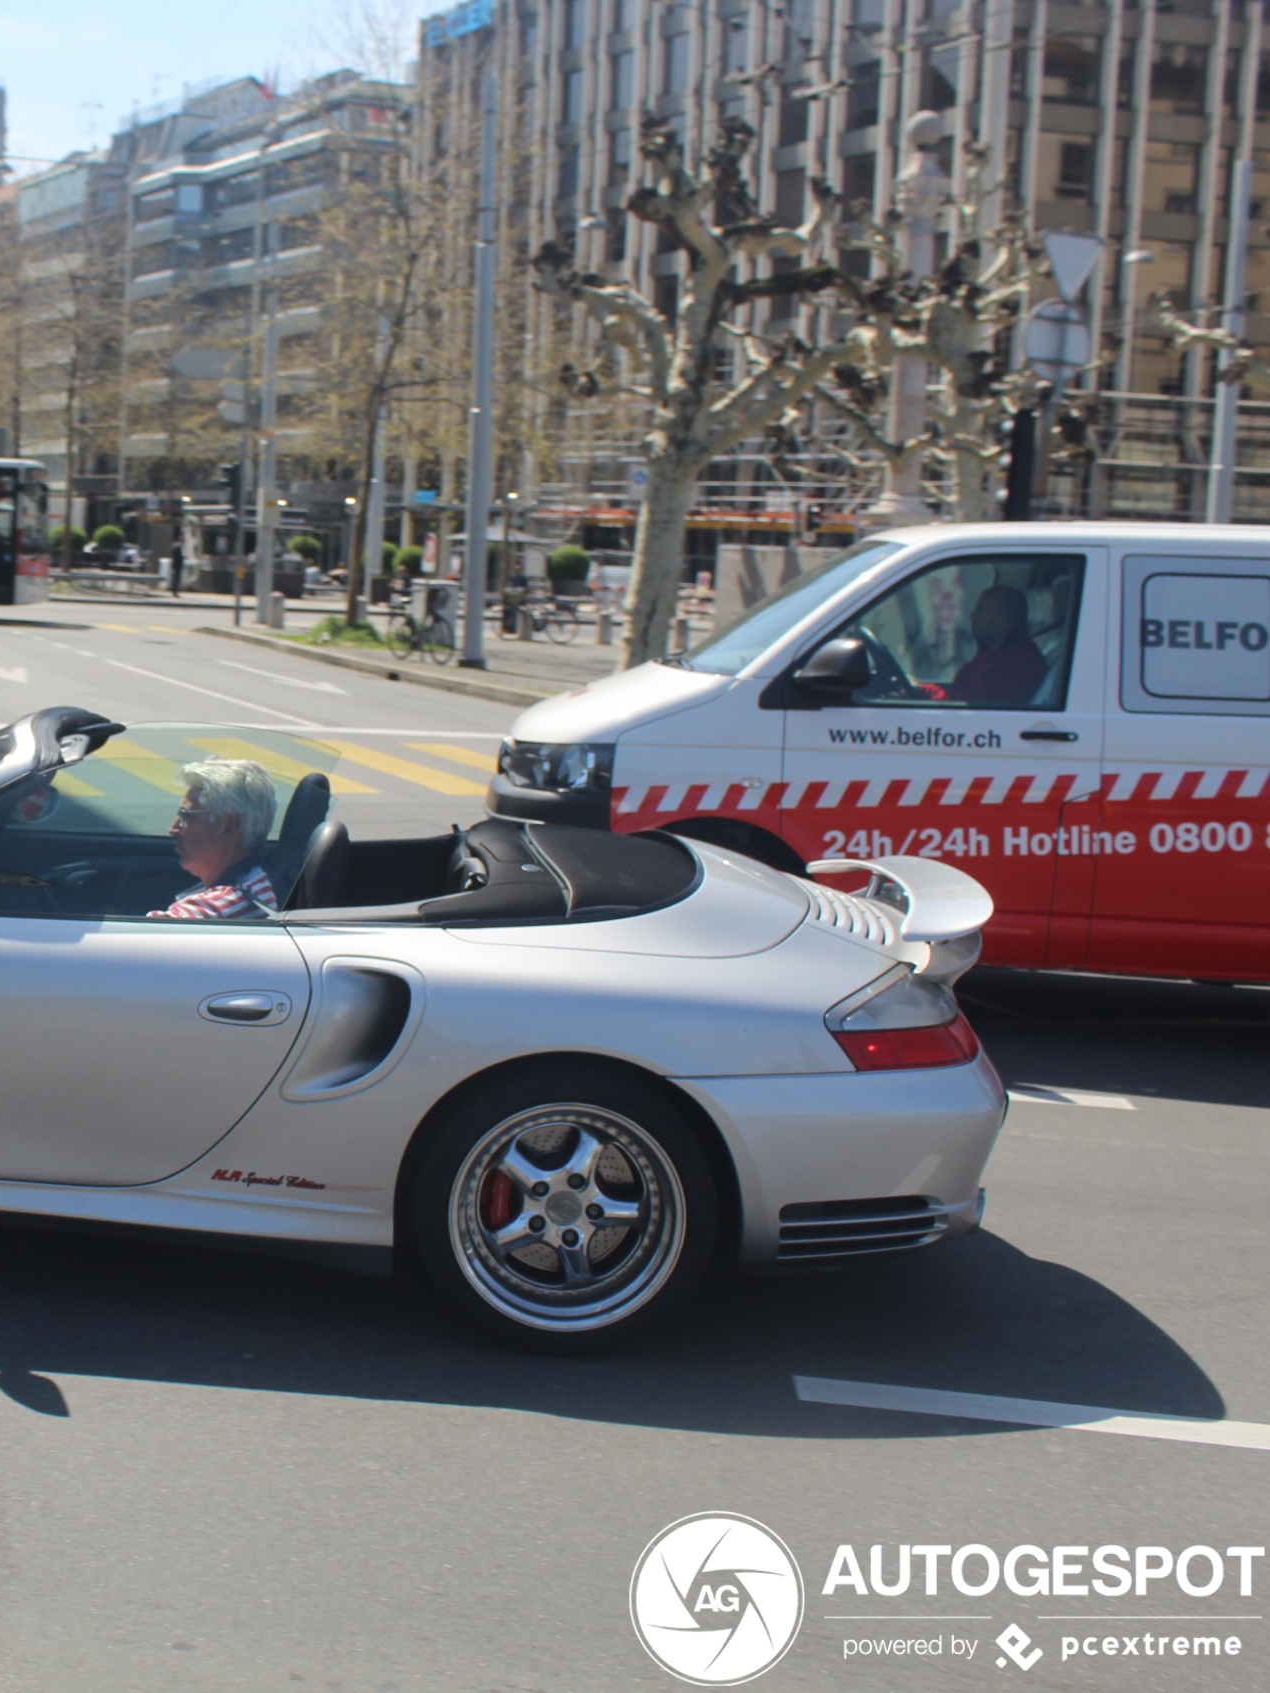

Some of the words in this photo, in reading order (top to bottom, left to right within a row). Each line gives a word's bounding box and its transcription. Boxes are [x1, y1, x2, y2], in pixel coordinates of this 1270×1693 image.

[828, 726, 1001, 748] www.belfor.ch
[822, 828, 990, 858] 24h/24h
[1003, 825, 1137, 857] Hotline
[1149, 821, 1253, 853] 0800
[242, 1171, 285, 1188] Special
